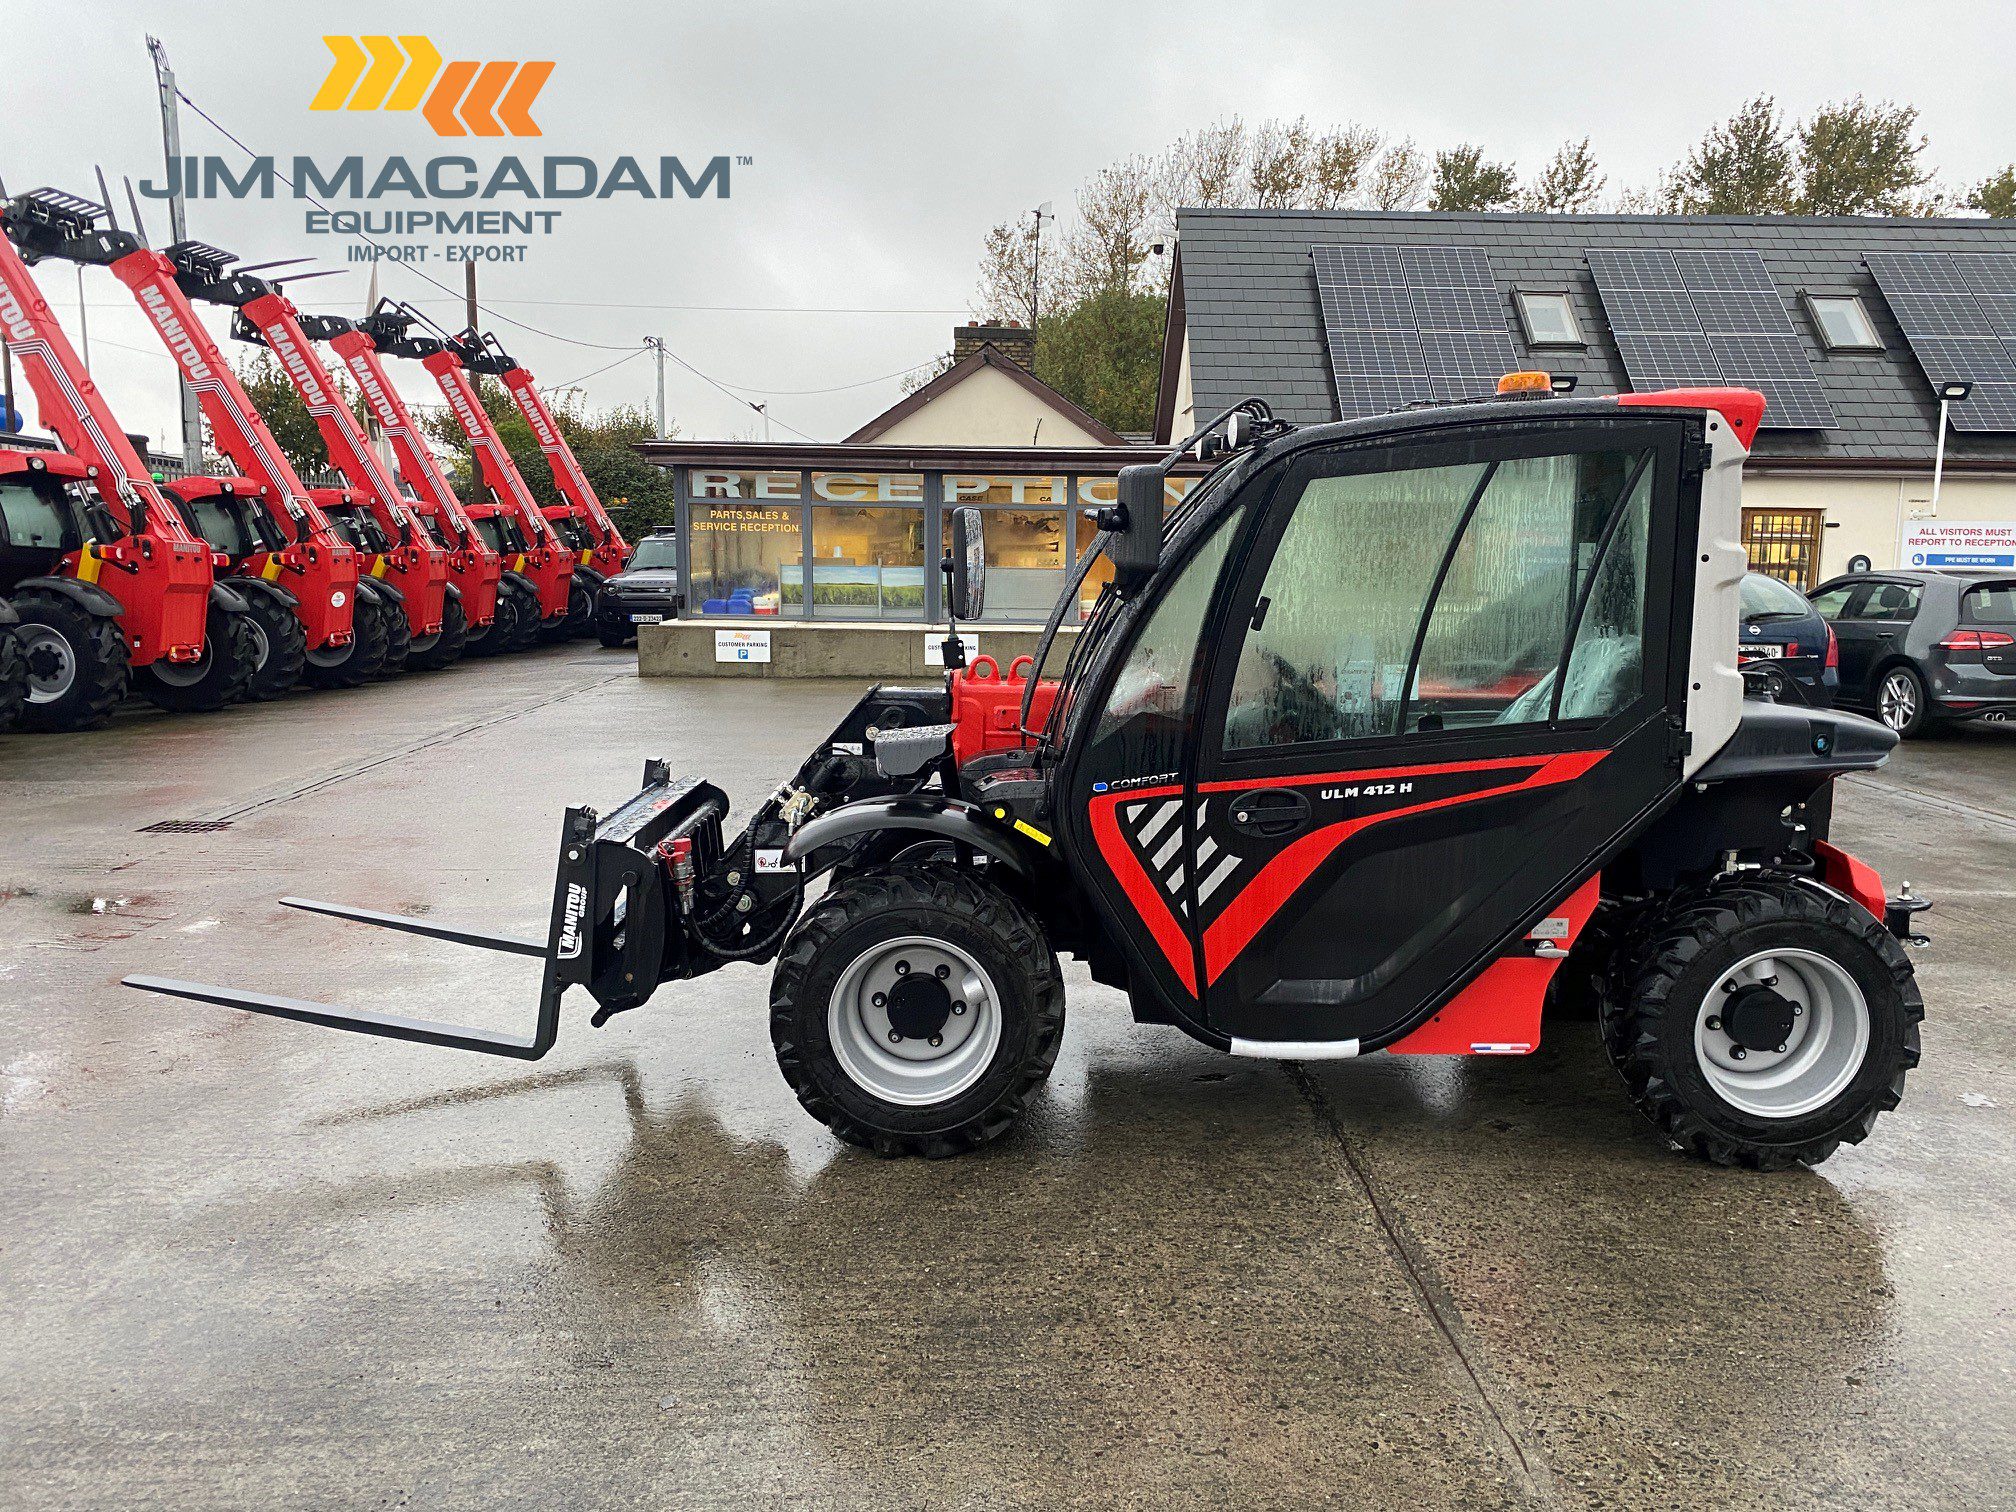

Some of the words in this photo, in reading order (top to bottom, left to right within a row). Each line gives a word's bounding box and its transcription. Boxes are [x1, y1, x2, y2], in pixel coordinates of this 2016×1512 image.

[139, 284, 212, 381] MANITOU
[267, 322, 328, 406] MANITOU
[350, 355, 400, 427] MANITOU
[439, 372, 484, 437] MANITOU
[514, 387, 556, 445] MANITOU
[693, 522, 737, 531] SERVICE
[740, 522, 799, 533] RECEPTION
[710, 510, 779, 521] PARTS,SALES
[782, 511, 790, 520] &
[1908, 538, 1947, 546] REPORT
[1949, 538, 1962, 546] TO
[1939, 528, 1983, 536] VISITORS
[1111, 772, 1179, 790] COMFORT
[1321, 786, 1358, 800] ULM
[1363, 784, 1396, 796] 412
[1400, 782, 1413, 793] H
[561, 882, 581, 949] MANITOU
[578, 886, 588, 918] GROUP
